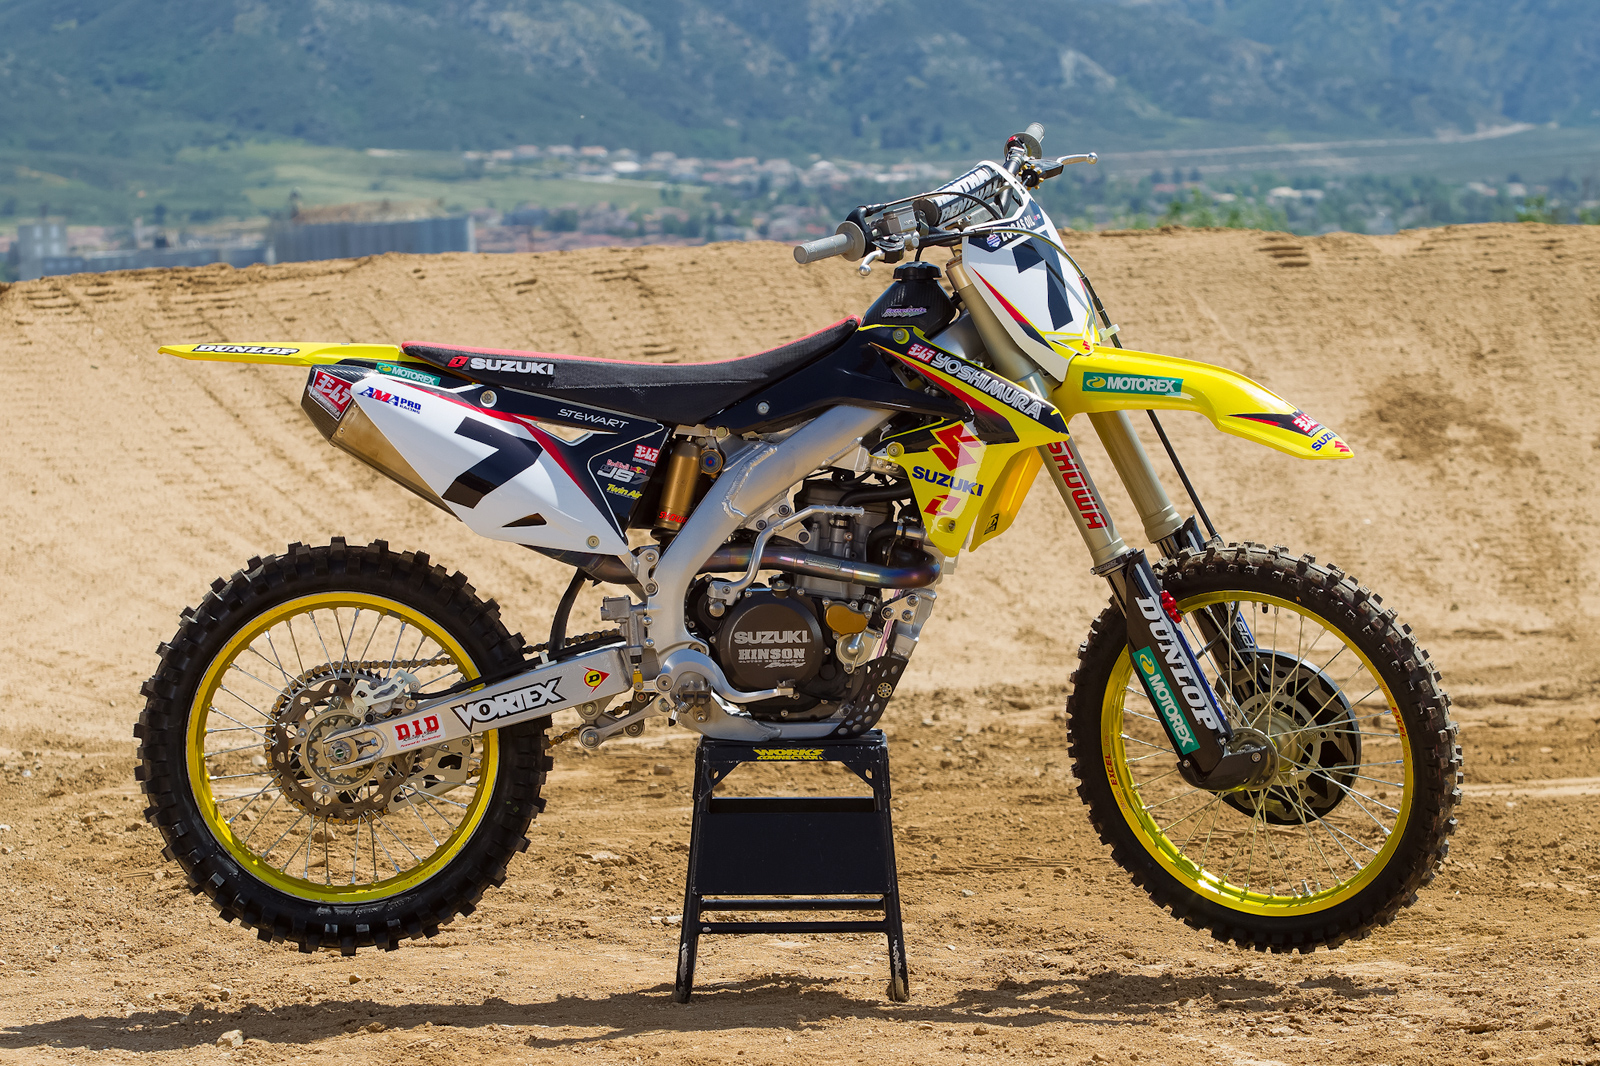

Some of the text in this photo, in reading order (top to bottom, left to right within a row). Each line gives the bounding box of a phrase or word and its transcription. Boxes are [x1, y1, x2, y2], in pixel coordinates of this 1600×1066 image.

[1023, 214, 1036, 228] OIL
[1012, 229, 1074, 331] 7
[193, 344, 299, 356] DUNLOP
[391, 366, 436, 385] MOTOREX
[470, 357, 554, 375] SUZUKI
[930, 352, 1042, 421] YOSHIMURA
[1106, 376, 1176, 393] MOTOREX
[357, 386, 421, 410] AMA PRO
[557, 408, 629, 429] STEWART
[1311, 432, 1336, 451] SUZU
[441, 416, 544, 509] 7
[606, 483, 628, 496] Twin
[627, 490, 642, 499] Air
[911, 465, 984, 497] SUZUKI
[1046, 441, 1108, 529] SHOWA
[734, 630, 808, 644] SUZUKI
[738, 648, 806, 660] HINSON
[1134, 596, 1219, 730] DUNLOP
[452, 677, 565, 731] VORTEX
[1148, 673, 1193, 748] MOTOREX
[753, 748, 825, 756] WORKS
[1105, 753, 1118, 786] EXCEL
